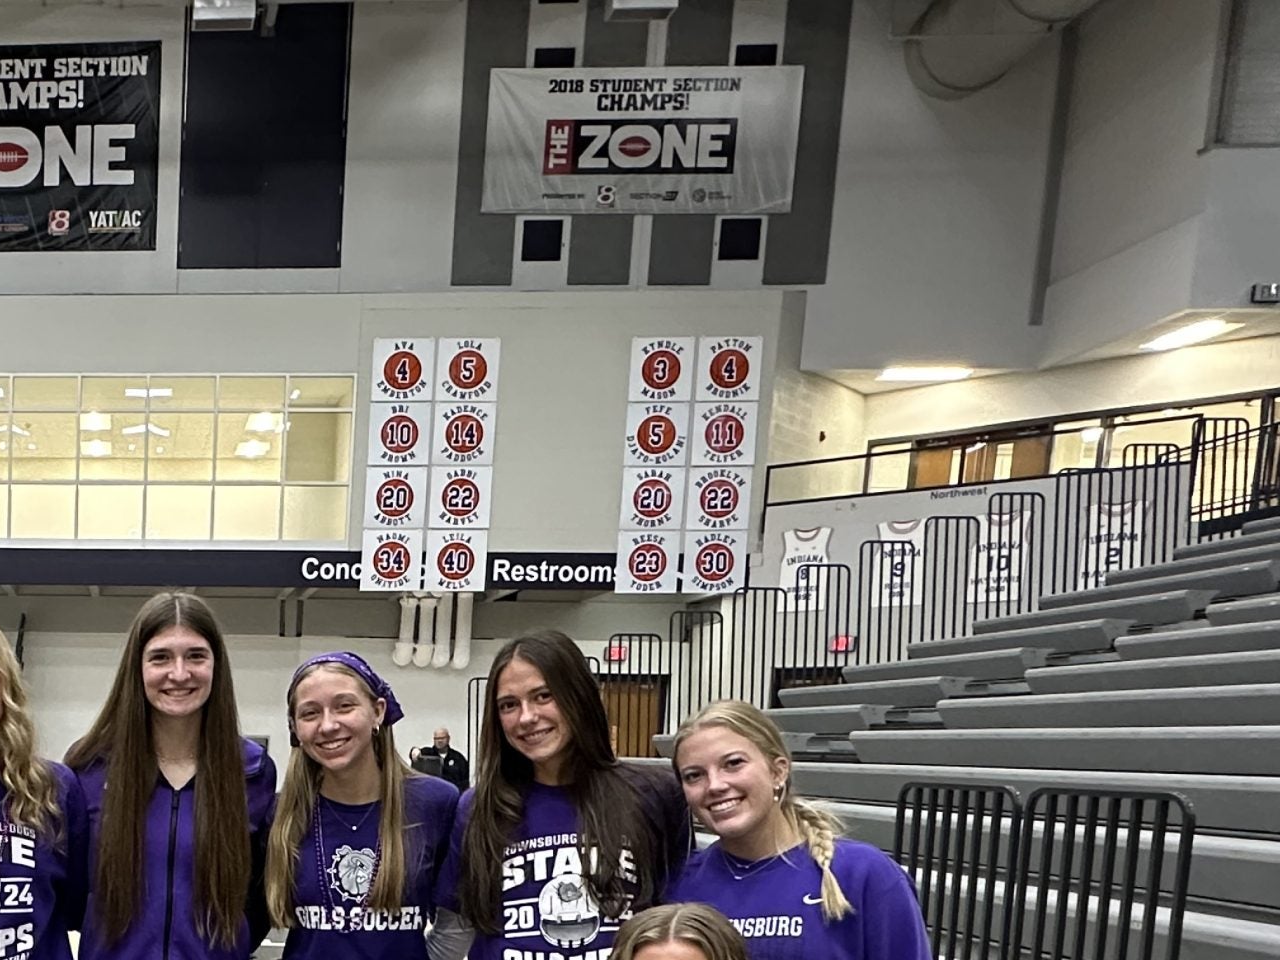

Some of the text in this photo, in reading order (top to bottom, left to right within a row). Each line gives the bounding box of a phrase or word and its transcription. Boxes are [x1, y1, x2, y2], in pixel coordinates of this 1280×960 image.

[54, 55, 148, 79] SECTION
[548, 77, 741, 93] 2018 STUDENT SECTION
[597, 93, 690, 111] CHAMPS!
[548, 125, 569, 169] THE
[577, 124, 731, 168] ZONE
[51, 210, 70, 231] 8
[394, 341, 414, 350] AVA
[457, 340, 482, 351] LOLA
[395, 358, 409, 383] 4
[461, 357, 476, 382] 5
[653, 358, 668, 382] 3
[722, 356, 736, 381] 4
[442, 380, 491, 399] CRAWFORD
[641, 387, 676, 400] MASON
[442, 405, 488, 421] KADENCE
[701, 404, 748, 421] KENDALL
[387, 422, 412, 446] 10
[452, 421, 477, 446] 14
[648, 422, 665, 447] 5
[712, 421, 736, 447] 11
[381, 451, 416, 462] BROWN
[440, 446, 484, 462] PADDOCK
[383, 470, 409, 480] NINA
[637, 469, 672, 481] SARAH
[695, 469, 746, 488] BROOKLYN
[382, 486, 408, 510] 20
[448, 485, 474, 509] 22
[638, 486, 665, 511] 20
[706, 486, 733, 512] 22
[930, 487, 988, 500] Northwest
[438, 511, 479, 525] HARVEY
[631, 513, 672, 527] THORNE
[377, 532, 410, 544] NAOMI
[443, 533, 472, 544] LEILA
[632, 534, 665, 545] REESE
[378, 548, 404, 573] 34
[443, 549, 469, 573] 40
[634, 550, 661, 575] 23
[701, 550, 728, 575] 30
[787, 556, 823, 566] INDIANA
[438, 578, 471, 589] WELLS
[630, 580, 662, 591] YODER
[691, 576, 734, 591] SIMPSON
[4, 884, 33, 906] 24
[295, 905, 345, 930] GIRLS
[504, 905, 535, 931] 20
